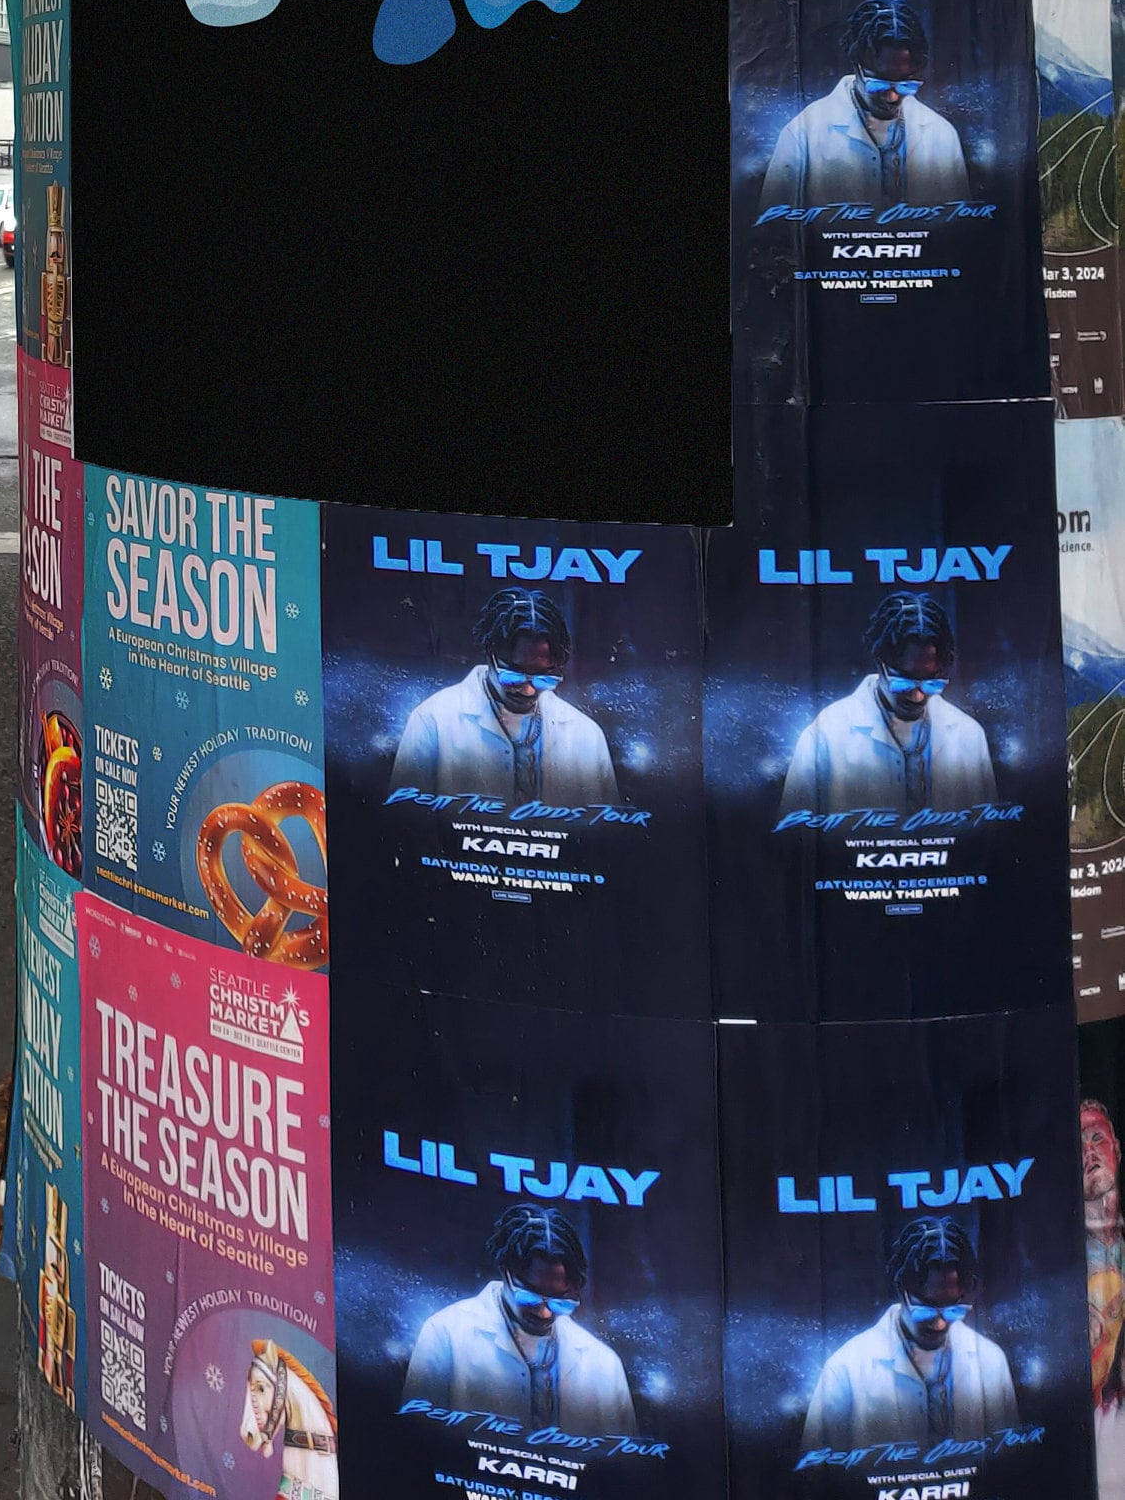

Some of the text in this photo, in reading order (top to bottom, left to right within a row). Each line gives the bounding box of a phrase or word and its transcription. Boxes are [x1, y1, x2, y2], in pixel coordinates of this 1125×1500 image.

[826, 202, 876, 223] THE
[822, 232, 850, 240] WITH
[851, 231, 895, 239] SPECIAL
[832, 244, 923, 259] KARRI
[821, 279, 934, 290] WAMU THEATER
[873, 269, 949, 279] DECEMBER
[1061, 267, 1073, 282] 3,
[1076, 266, 1105, 280] 2024
[32, 448, 62, 532] THE
[106, 474, 197, 549] SAVOR
[205, 492, 276, 561] THE
[23, 511, 62, 610] SON
[373, 536, 643, 583] LIL TJAY
[1059, 540, 1094, 554] cience.
[759, 545, 1013, 584] LIL TJAY
[107, 538, 277, 654] SEASON
[109, 627, 277, 681] A European Christmas Village
[128, 649, 251, 692] in the Heart of Seattle
[95, 725, 139, 766] TICKETS
[105, 760, 121, 781] SALE
[122, 767, 138, 788] NOW
[166, 726, 313, 830] YOUR NEWEST HOLIDAY TRADITION!
[457, 793, 506, 814] THE
[452, 822, 568, 840] WITH SPECIAL GUEST
[850, 808, 899, 831] THE
[462, 837, 560, 859] KARRI
[845, 836, 956, 848] WITH SPECIAL GUEST
[855, 850, 949, 868] KARRI
[1070, 867, 1084, 879] ar
[1086, 863, 1099, 878] 3,
[451, 870, 573, 893] WAMU THEATER
[505, 866, 590, 884] DECEMBER
[898, 875, 975, 888] DECEMBER
[844, 887, 960, 901] WAMU THEATER
[209, 967, 271, 999] SEATTLE
[210, 999, 280, 1036] MARKET
[96, 997, 305, 1164] TREASURE
[97, 1078, 150, 1173] THE
[158, 1116, 309, 1242] SEASON
[384, 1129, 661, 1207] LIL TJAY
[778, 1157, 1035, 1213] LIL TJAY
[100, 1152, 308, 1268] A European Christmas Village
[135, 1194, 156, 1220] the
[159, 1211, 196, 1243] Heart
[199, 1233, 214, 1252] of
[216, 1238, 275, 1276] Seattle
[99, 1261, 145, 1320] TICKETS
[200, 1289, 241, 1311] HOLIDAY
[246, 1290, 318, 1333] TRADITION!
[471, 1410, 524, 1436] THE
[467, 1439, 587, 1471] WITH SPECIAL GUEST
[871, 1441, 921, 1466] THE
[478, 1456, 578, 1490] KARRI
[866, 1466, 978, 1485] WITH SPECIAL GUEST
[878, 1481, 970, 1500] KARRI
